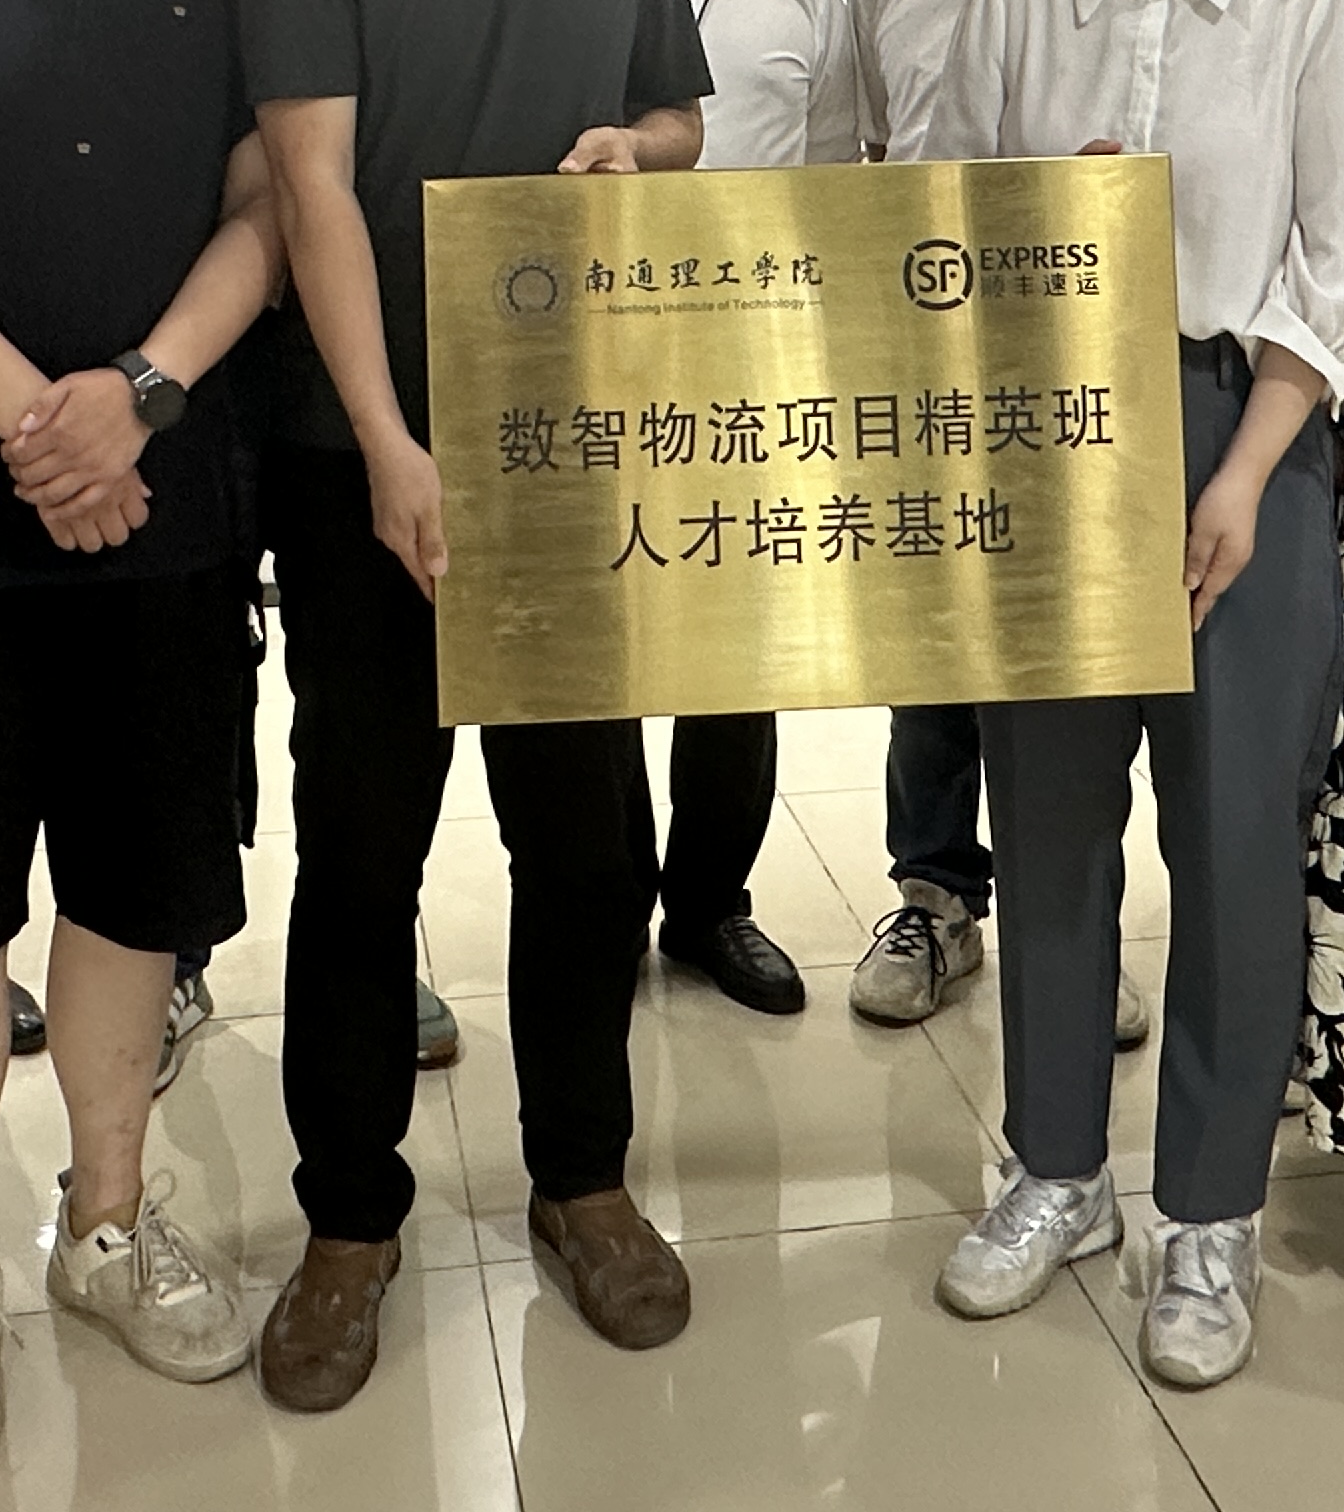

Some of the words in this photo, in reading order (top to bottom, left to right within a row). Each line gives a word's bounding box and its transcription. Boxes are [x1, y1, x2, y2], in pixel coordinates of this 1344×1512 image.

[979, 243, 1099, 271] EXPRESS
[916, 259, 960, 293] SF
[980, 271, 1100, 298] 顺丰速运
[663, 302, 714, 313] Institute
[717, 300, 729, 311] of
[732, 298, 805, 311] Technology
[499, 384, 1114, 473] 数智物流项目精英班
[610, 488, 1014, 571] 人才培养基地
